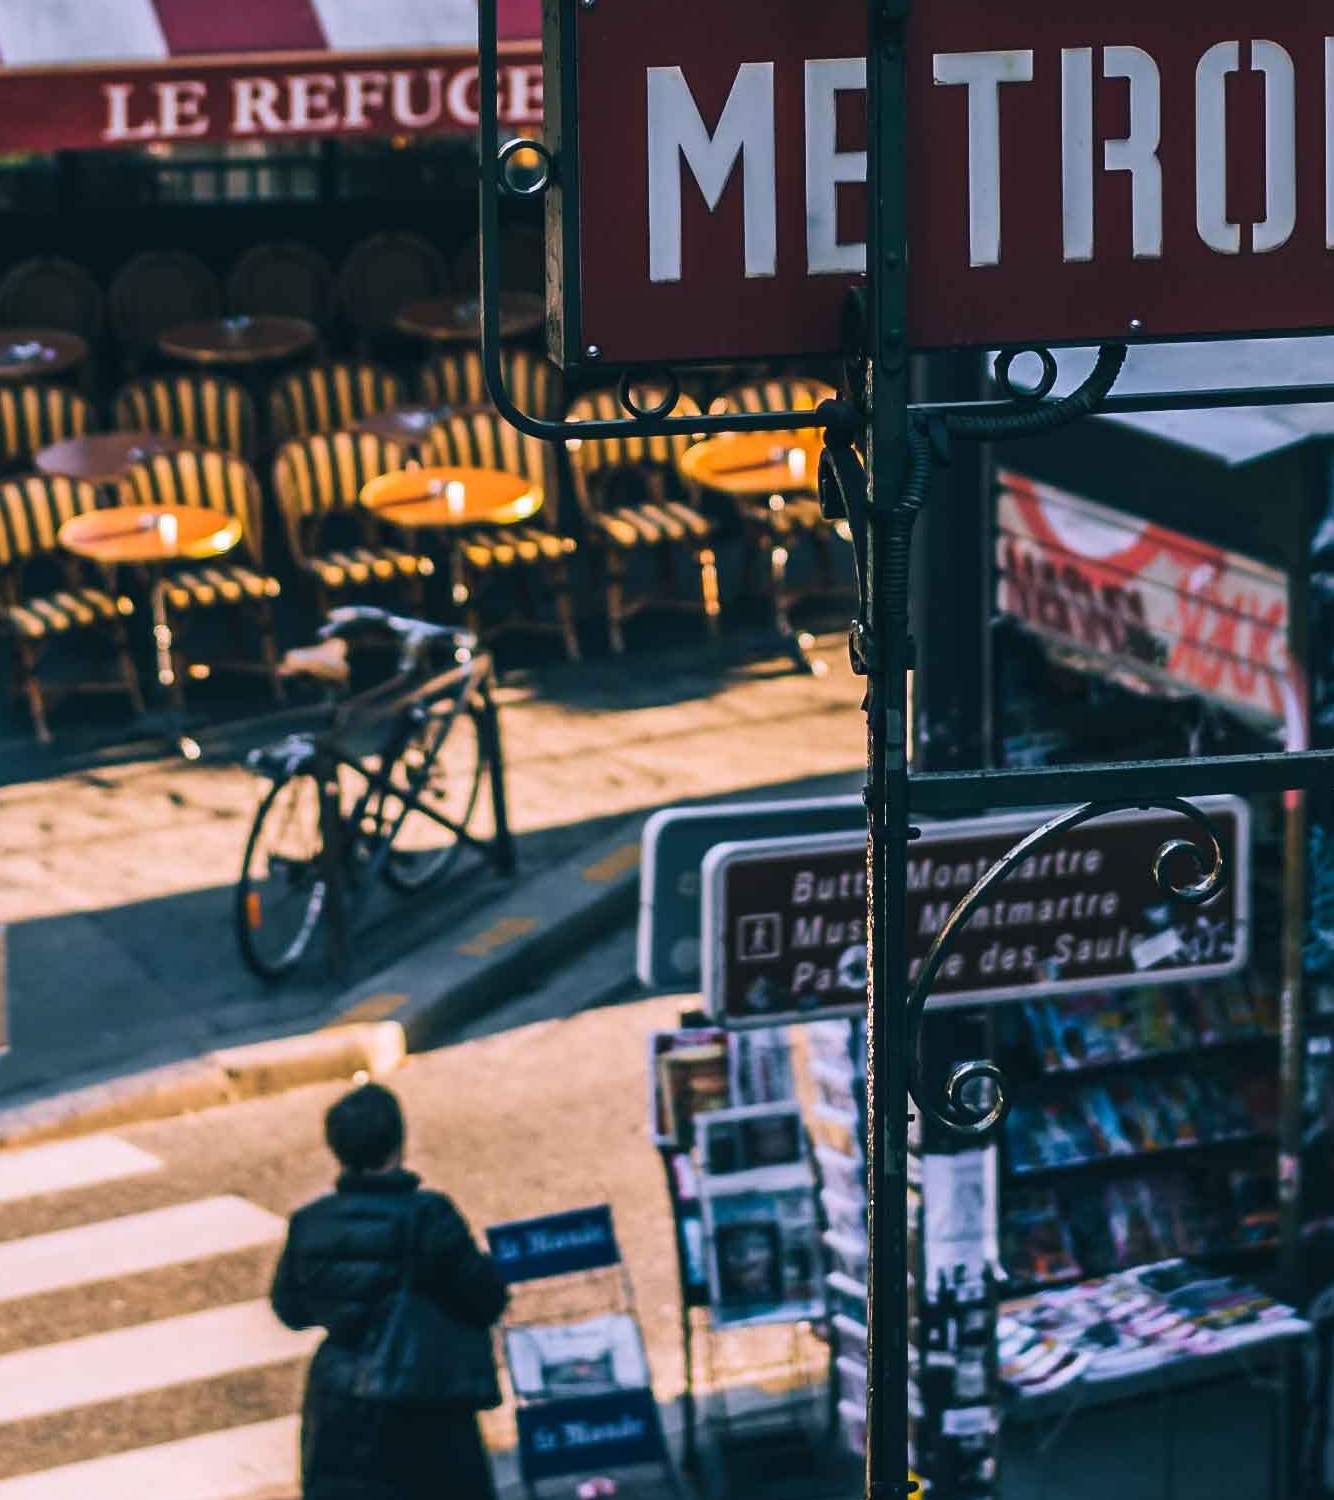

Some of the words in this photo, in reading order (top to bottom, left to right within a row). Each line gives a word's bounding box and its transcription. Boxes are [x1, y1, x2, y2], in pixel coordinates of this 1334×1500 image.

[103, 82, 207, 141] LE
[907, 849, 1103, 890] Montartre
[919, 890, 1118, 936] Mntmartre
[979, 942, 1035, 974] des
